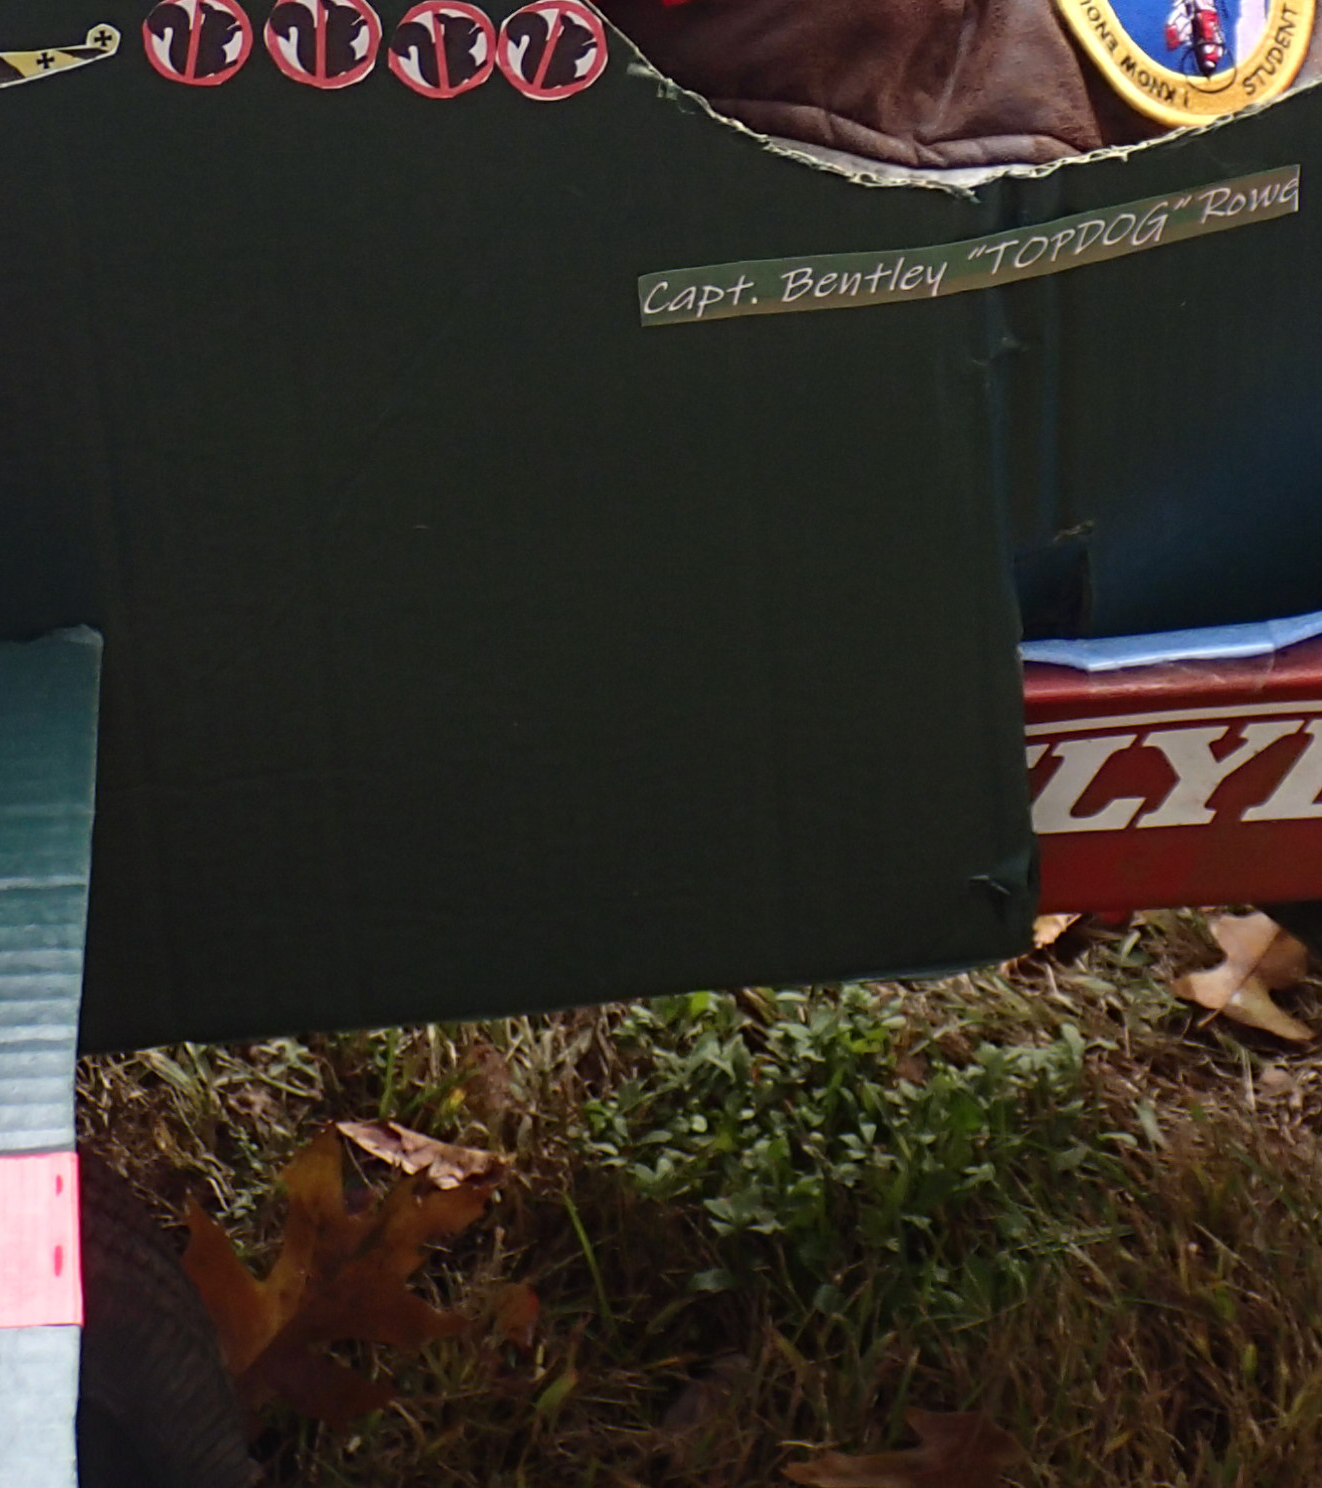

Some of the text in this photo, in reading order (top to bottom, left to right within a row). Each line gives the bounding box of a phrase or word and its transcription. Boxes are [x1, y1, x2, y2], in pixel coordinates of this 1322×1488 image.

[1120, 54, 1177, 105] KNOW
[1241, 2, 1299, 97] STUDENT
[643, 274, 758, 318] Capt.
[780, 256, 948, 298] Bentley
[967, 195, 1193, 275] "TOPDOG"
